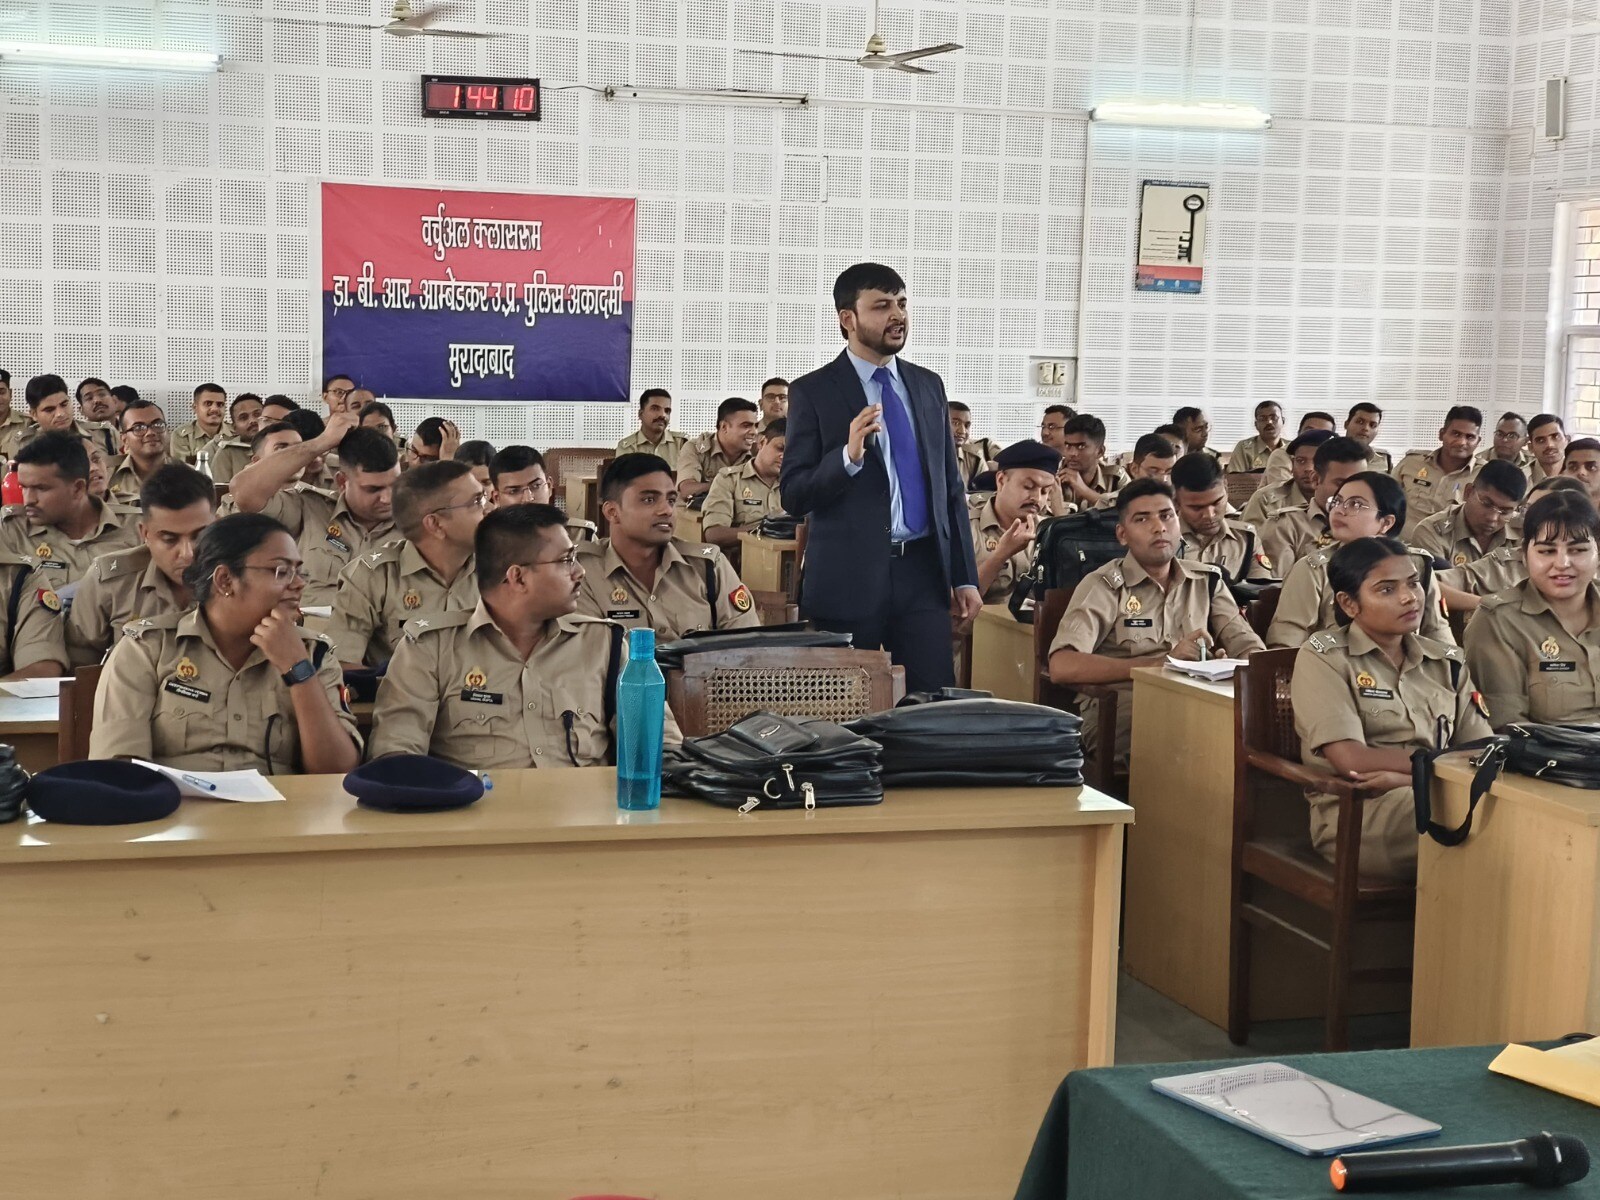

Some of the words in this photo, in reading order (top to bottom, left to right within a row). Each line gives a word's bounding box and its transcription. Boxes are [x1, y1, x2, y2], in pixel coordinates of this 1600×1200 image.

[513, 87, 534, 110] 10
[421, 202, 471, 261] वर्चुअल
[472, 218, 542, 251] क्लासरूम
[356, 261, 378, 308] बी.
[382, 277, 415, 309] आर.
[419, 266, 490, 312] आम्बेडकर
[523, 269, 565, 327] पुलिस
[567, 270, 624, 319] अकादमी
[448, 343, 515, 388] मुरादाबाद
